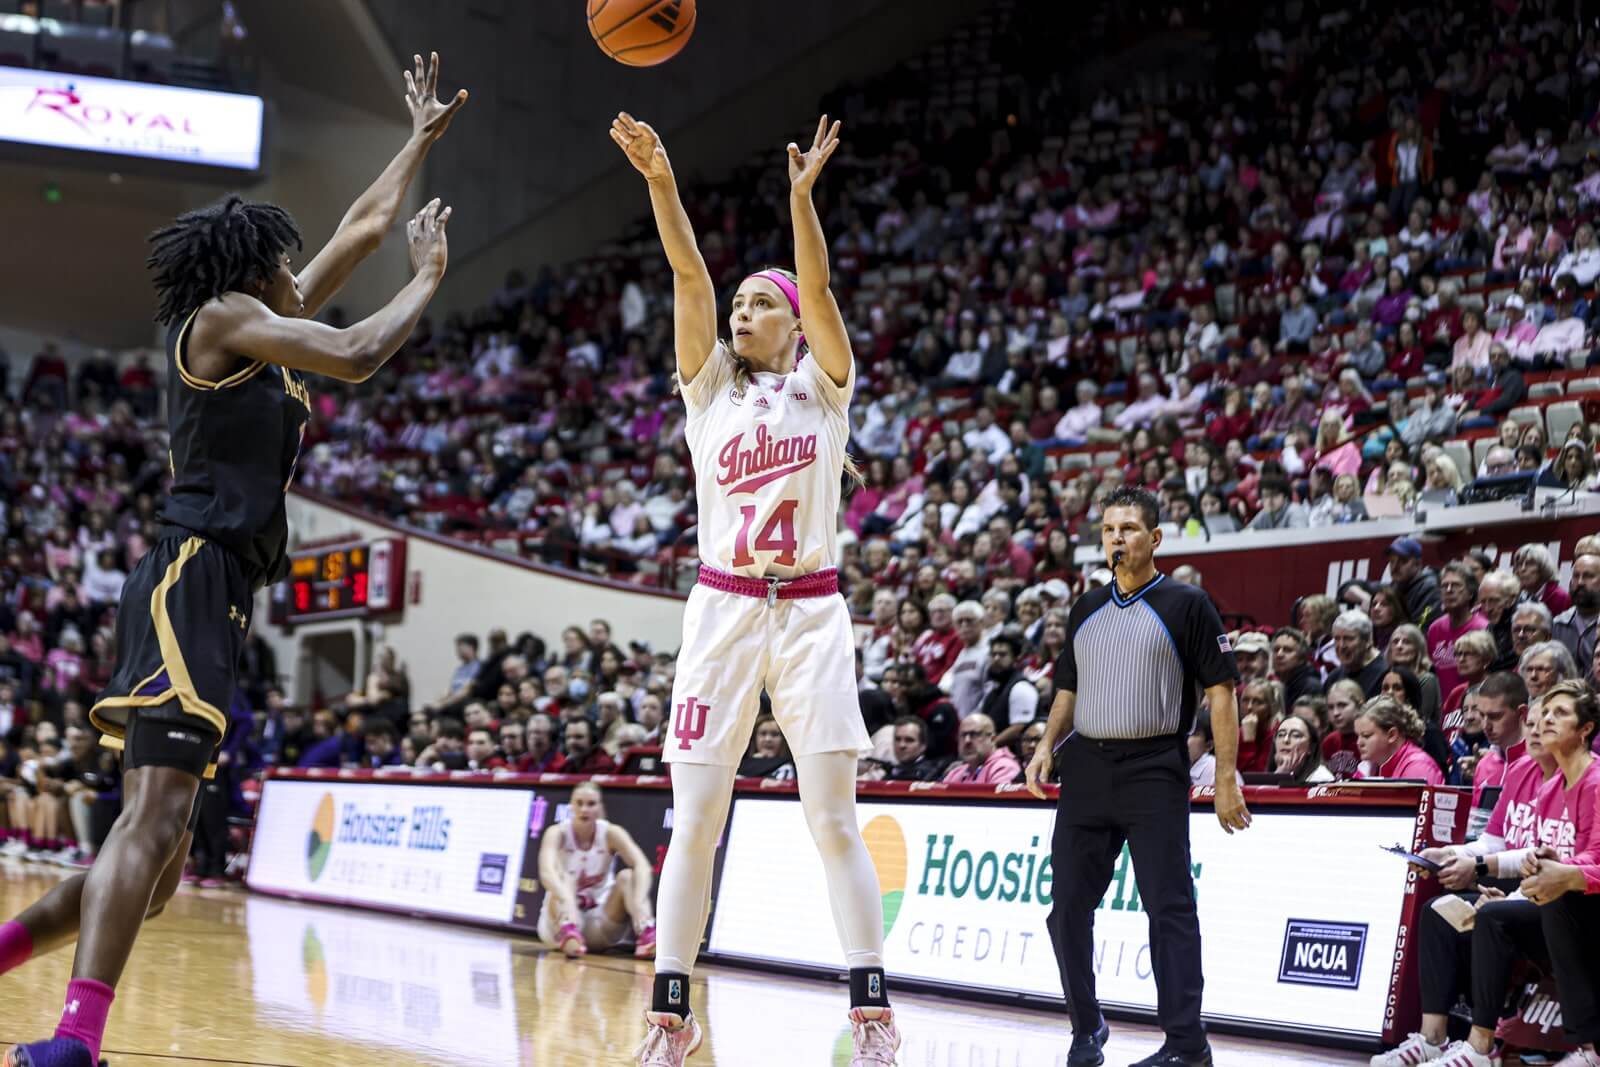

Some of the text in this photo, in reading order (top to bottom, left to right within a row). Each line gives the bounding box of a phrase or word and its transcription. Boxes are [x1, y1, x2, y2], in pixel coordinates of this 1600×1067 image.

[716, 423, 817, 487] Indiana
[732, 500, 799, 568] 14
[337, 802, 452, 851] Hoosier Hills
[918, 834, 1054, 906] Hoosie
[908, 921, 1034, 967] CREDIT
[1293, 942, 1347, 971] NCUA
[1383, 925, 1407, 1030] RUOFF.COM
